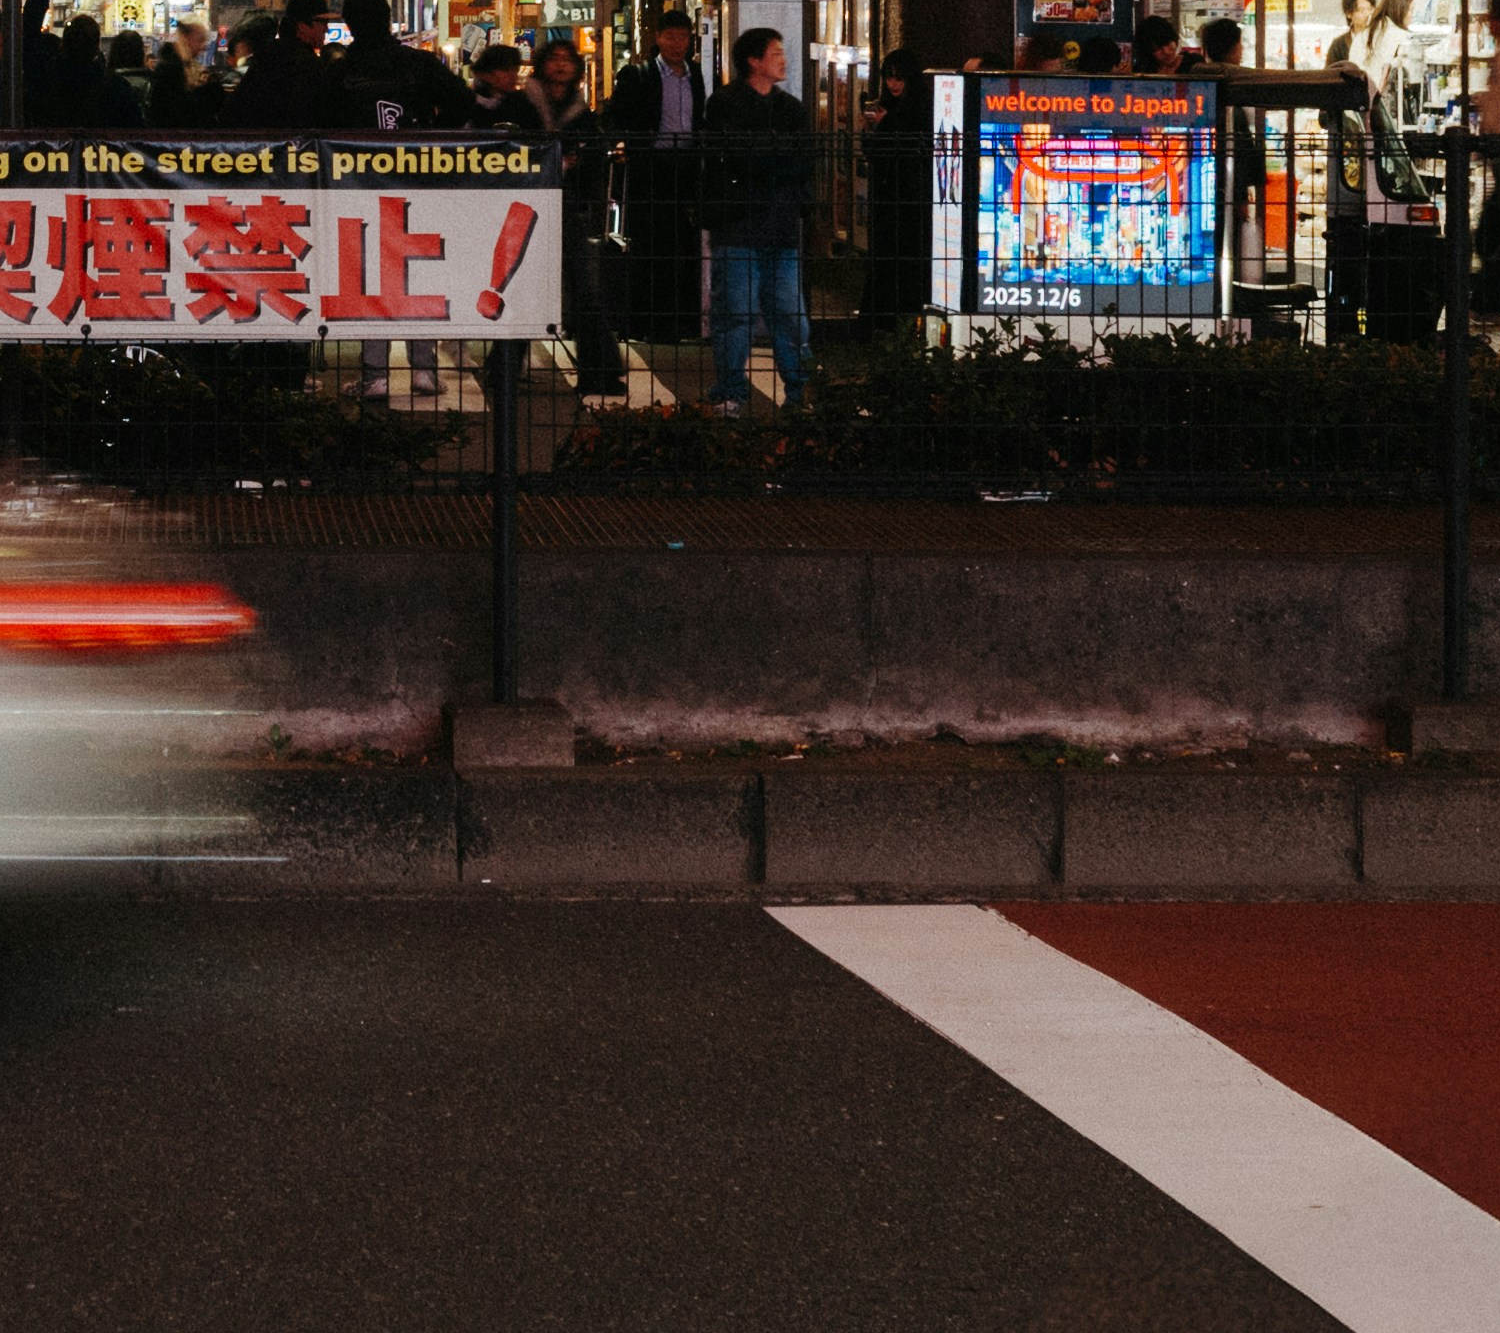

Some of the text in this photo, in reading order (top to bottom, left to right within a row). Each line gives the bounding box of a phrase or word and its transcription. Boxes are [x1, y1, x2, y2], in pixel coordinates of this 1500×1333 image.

[985, 92, 1188, 117] welcome to Japan
[23, 149, 72, 174] on
[83, 142, 146, 174] the
[155, 144, 275, 174] street
[286, 143, 321, 174] is
[331, 142, 543, 182] prohibited.
[982, 286, 1082, 310] 2025 12/6
